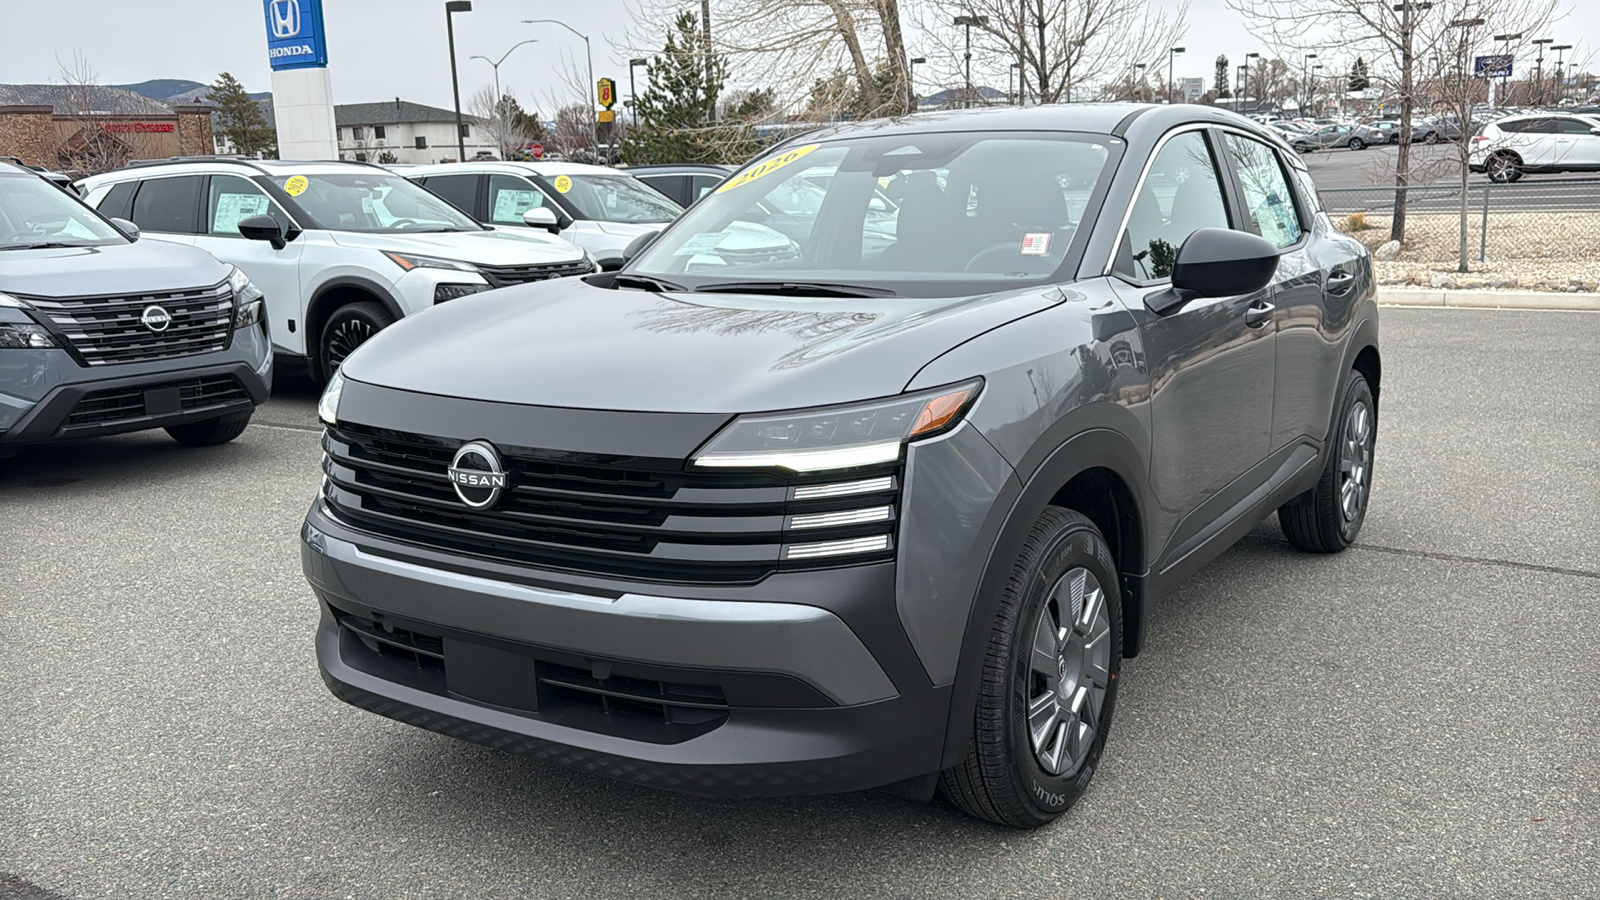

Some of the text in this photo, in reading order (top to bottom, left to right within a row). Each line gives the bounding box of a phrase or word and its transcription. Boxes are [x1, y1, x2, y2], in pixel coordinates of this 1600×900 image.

[269, 45, 314, 58] HONDA
[602, 87, 610, 101] 8
[134, 121, 175, 133] STRIKE
[732, 152, 798, 188] 2026
[141, 314, 171, 323] NISSAN
[447, 469, 504, 486] NISSAN
[1031, 778, 1066, 807] SOLUS
